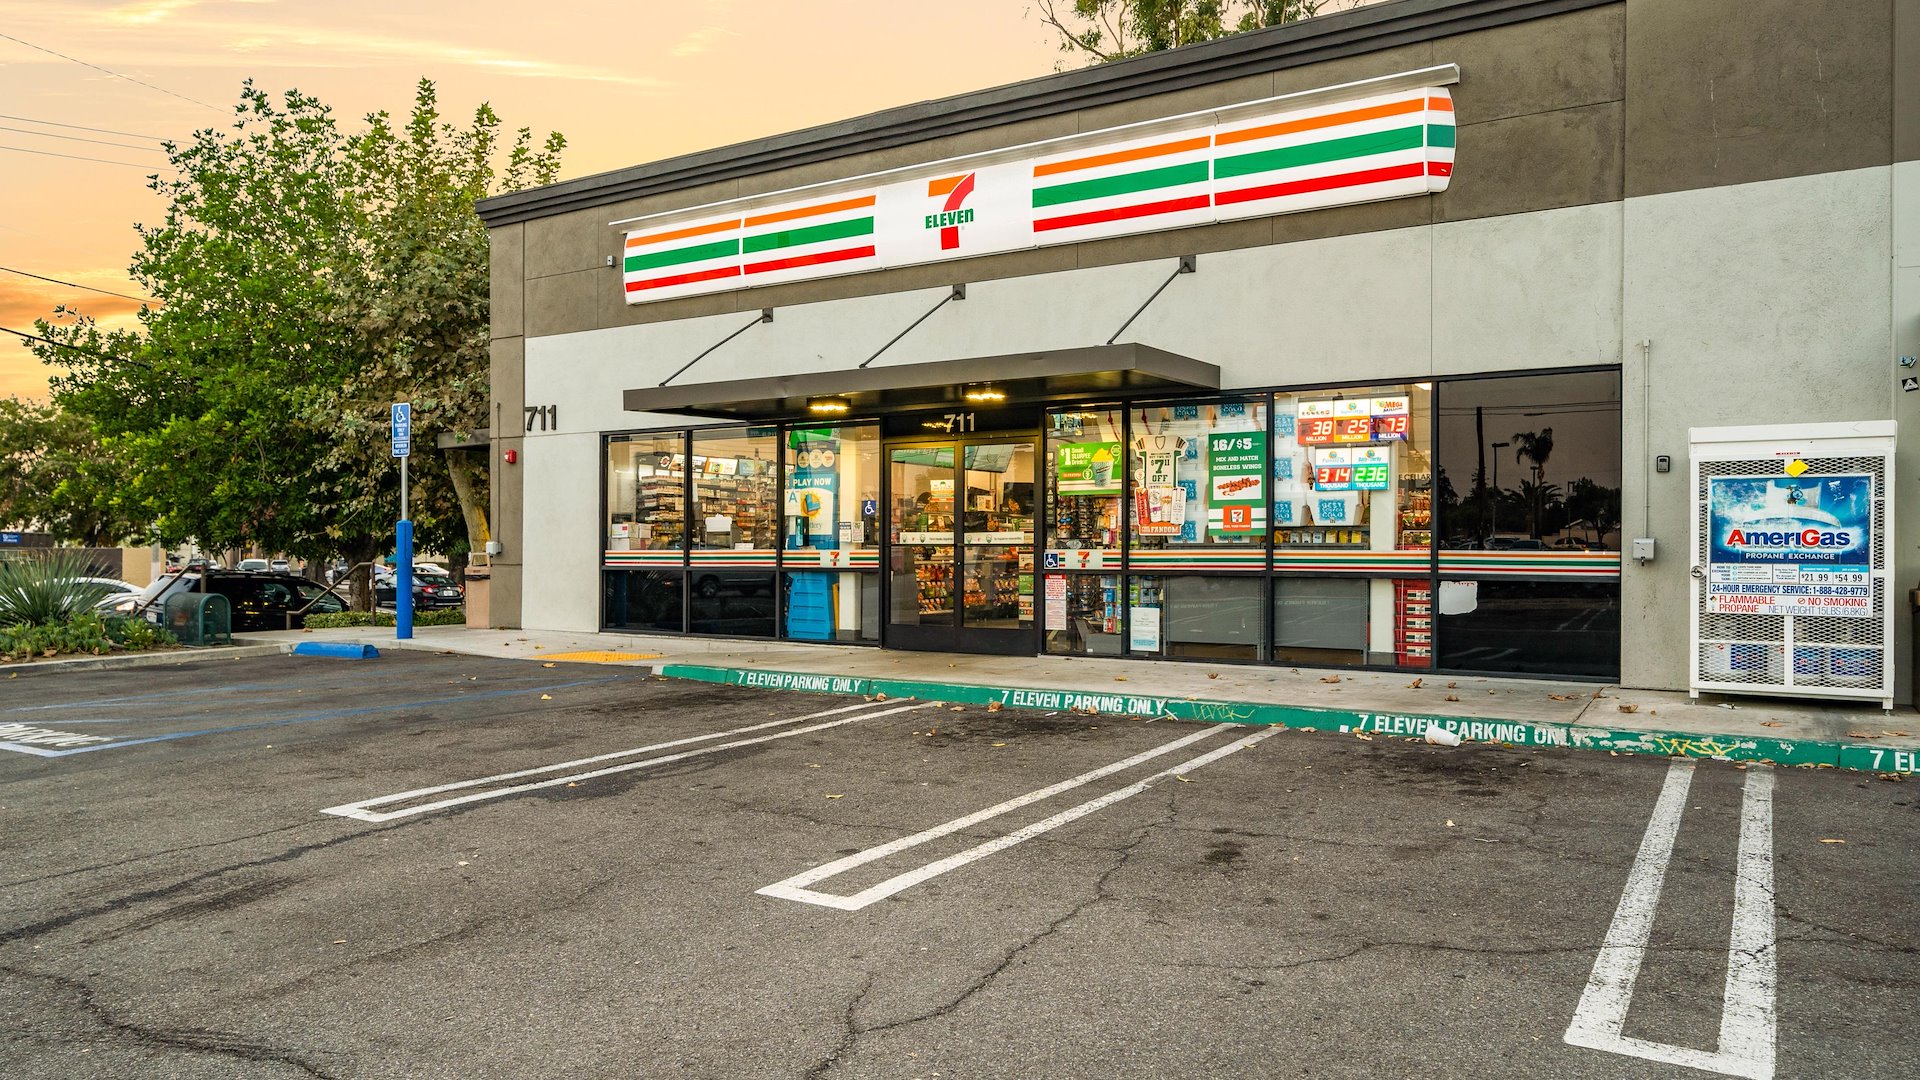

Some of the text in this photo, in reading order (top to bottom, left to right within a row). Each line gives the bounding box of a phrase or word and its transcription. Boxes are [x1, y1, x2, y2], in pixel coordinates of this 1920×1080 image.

[928, 172, 975, 250] 7
[524, 404, 557, 431] 711
[944, 413, 975, 433] 711
[1312, 418, 1406, 435] 38 25 73
[793, 477, 832, 486] PLAY NOW
[1354, 467, 1387, 481] 236
[788, 491, 797, 502] A
[1727, 529, 1850, 546] AmeriGas
[1712, 584, 1868, 596] 24-HOUR EMERGENCY SERVICE: 1-888-428-9779
[1719, 595, 1775, 604] FLAMMABLE
[1808, 598, 1867, 607] NO SMOKING
[1719, 604, 1759, 613] PROPANE
[1768, 605, 1785, 614] NET
[1785, 605, 1817, 615] WEIGHT
[738, 671, 861, 692] 7 ELEVEN PARKING ONLY
[1001, 691, 1165, 715] 7 ELEVEN PARKING ONLY
[1358, 714, 1368, 731] 7
[1446, 720, 1525, 743] PARKING
[1869, 750, 1884, 769] 7
